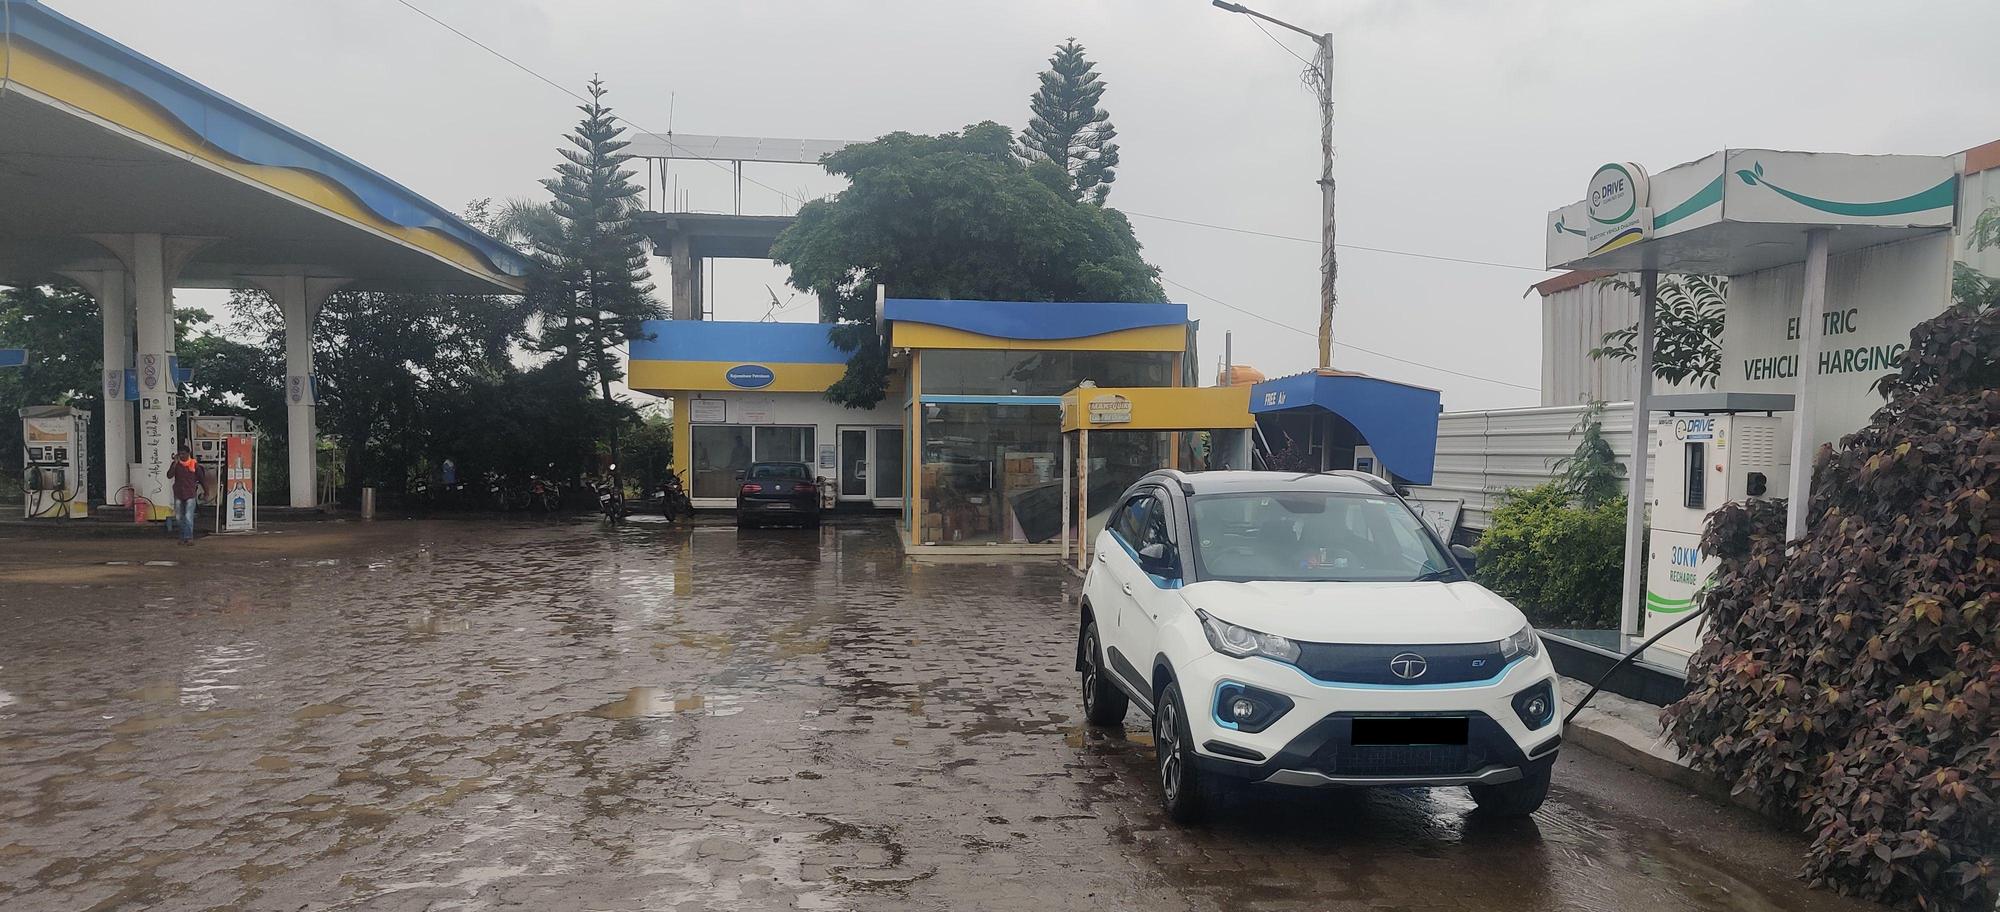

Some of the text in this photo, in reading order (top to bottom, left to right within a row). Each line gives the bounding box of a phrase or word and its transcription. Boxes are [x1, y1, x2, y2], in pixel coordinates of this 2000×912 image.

[1602, 178, 1624, 199] DRIVE
[1787, 308, 1858, 340] ELTRIC
[1263, 391, 1287, 406] FREE Air
[1687, 418, 1715, 432] DRIVE
[1671, 545, 1697, 568] 30KW
[1669, 570, 1697, 586] RECHARGE
[1472, 659, 1486, 667] EV
